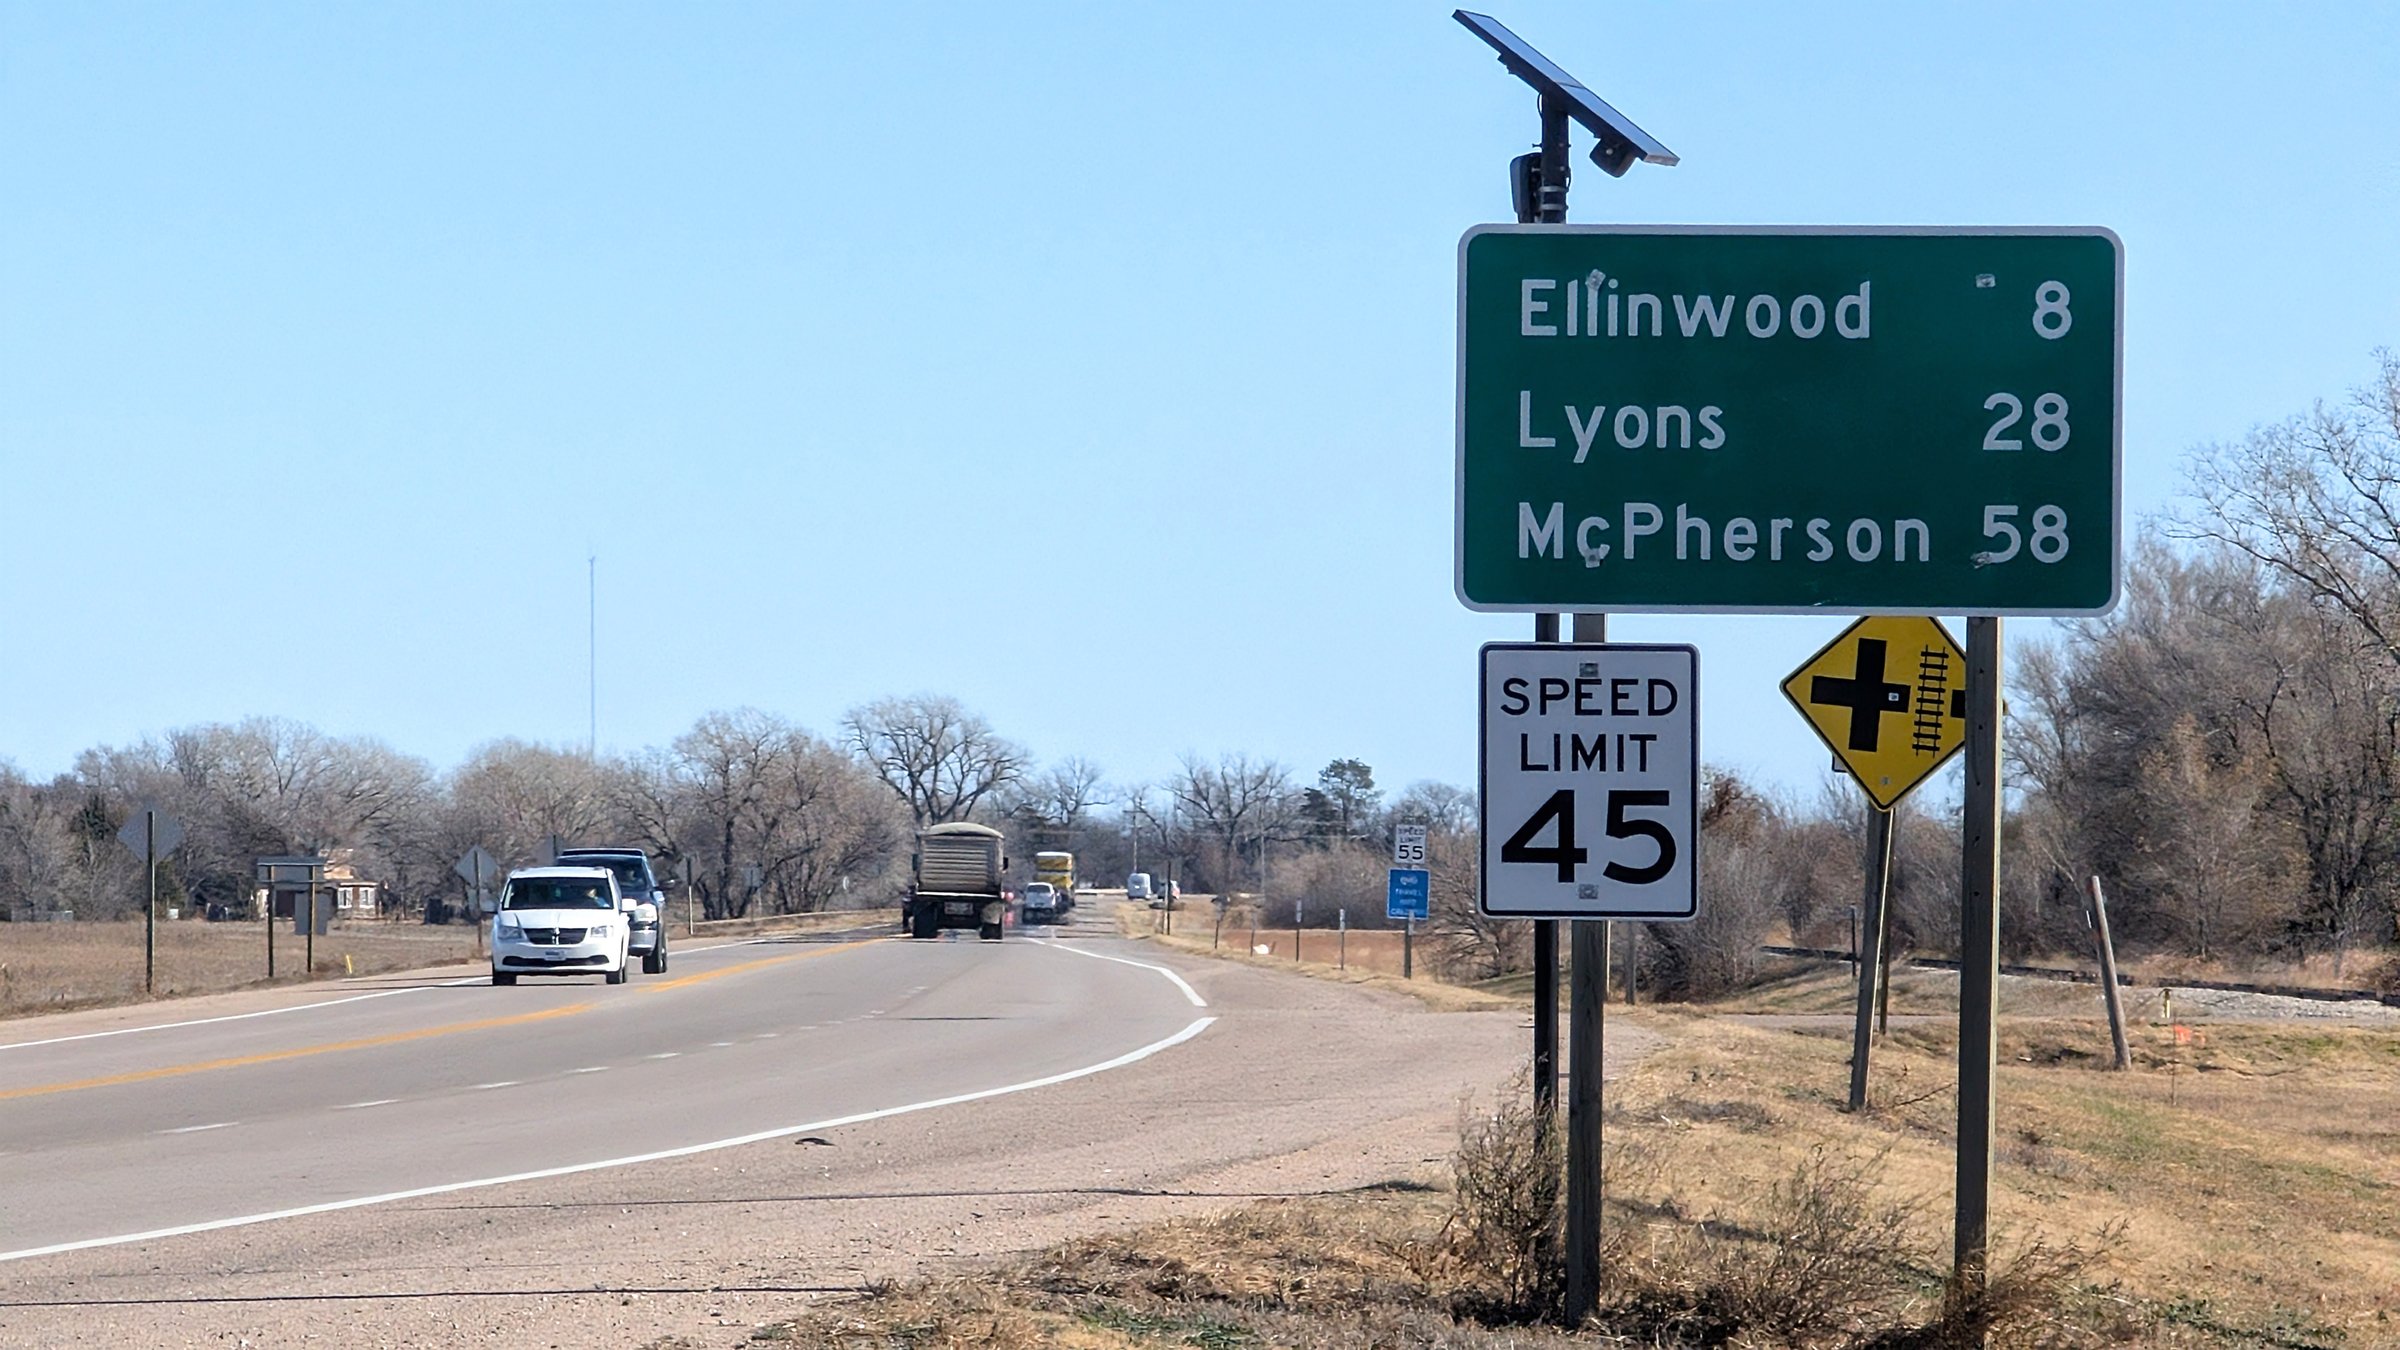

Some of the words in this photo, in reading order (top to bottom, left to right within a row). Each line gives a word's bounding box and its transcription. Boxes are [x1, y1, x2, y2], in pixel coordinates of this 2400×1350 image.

[1520, 278, 1871, 339] Ellinwood
[2032, 280, 2073, 340] 8
[1519, 390, 1726, 464] Lyons
[1982, 392, 2071, 452] 28
[1518, 502, 1930, 564] McPherson
[1980, 504, 2069, 564] 58
[1500, 677, 1678, 717] SPEED
[1520, 733, 1657, 773] LIMIT
[1398, 844, 1424, 861] 55
[1501, 789, 1677, 885] 45
